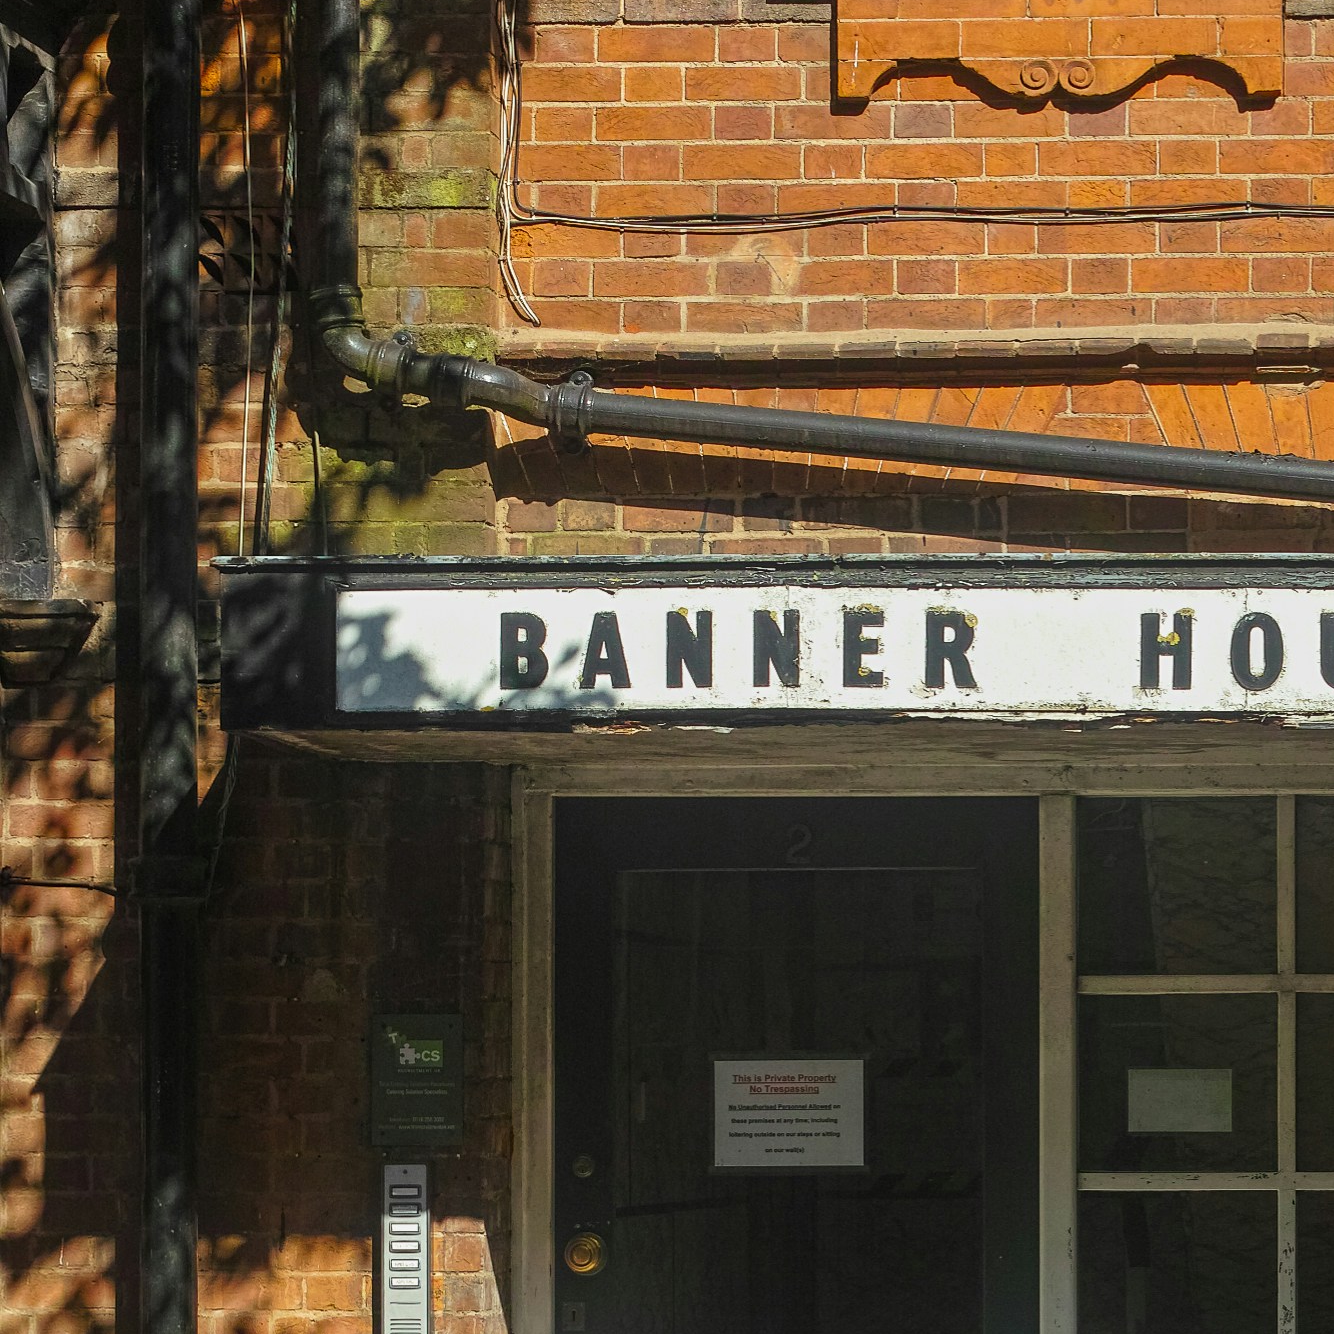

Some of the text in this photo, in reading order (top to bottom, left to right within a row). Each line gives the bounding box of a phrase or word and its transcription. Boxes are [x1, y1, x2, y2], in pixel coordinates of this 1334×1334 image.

[499, 609, 976, 692] BANNER
[732, 1073, 837, 1084] This is Private Property
[749, 1084, 820, 1095] No Trespassing
[811, 1117, 838, 1125] including
[729, 1131, 753, 1139] loitering
[822, 1131, 841, 1139] sitting
[785, 1146, 805, 1154] wall(s)
